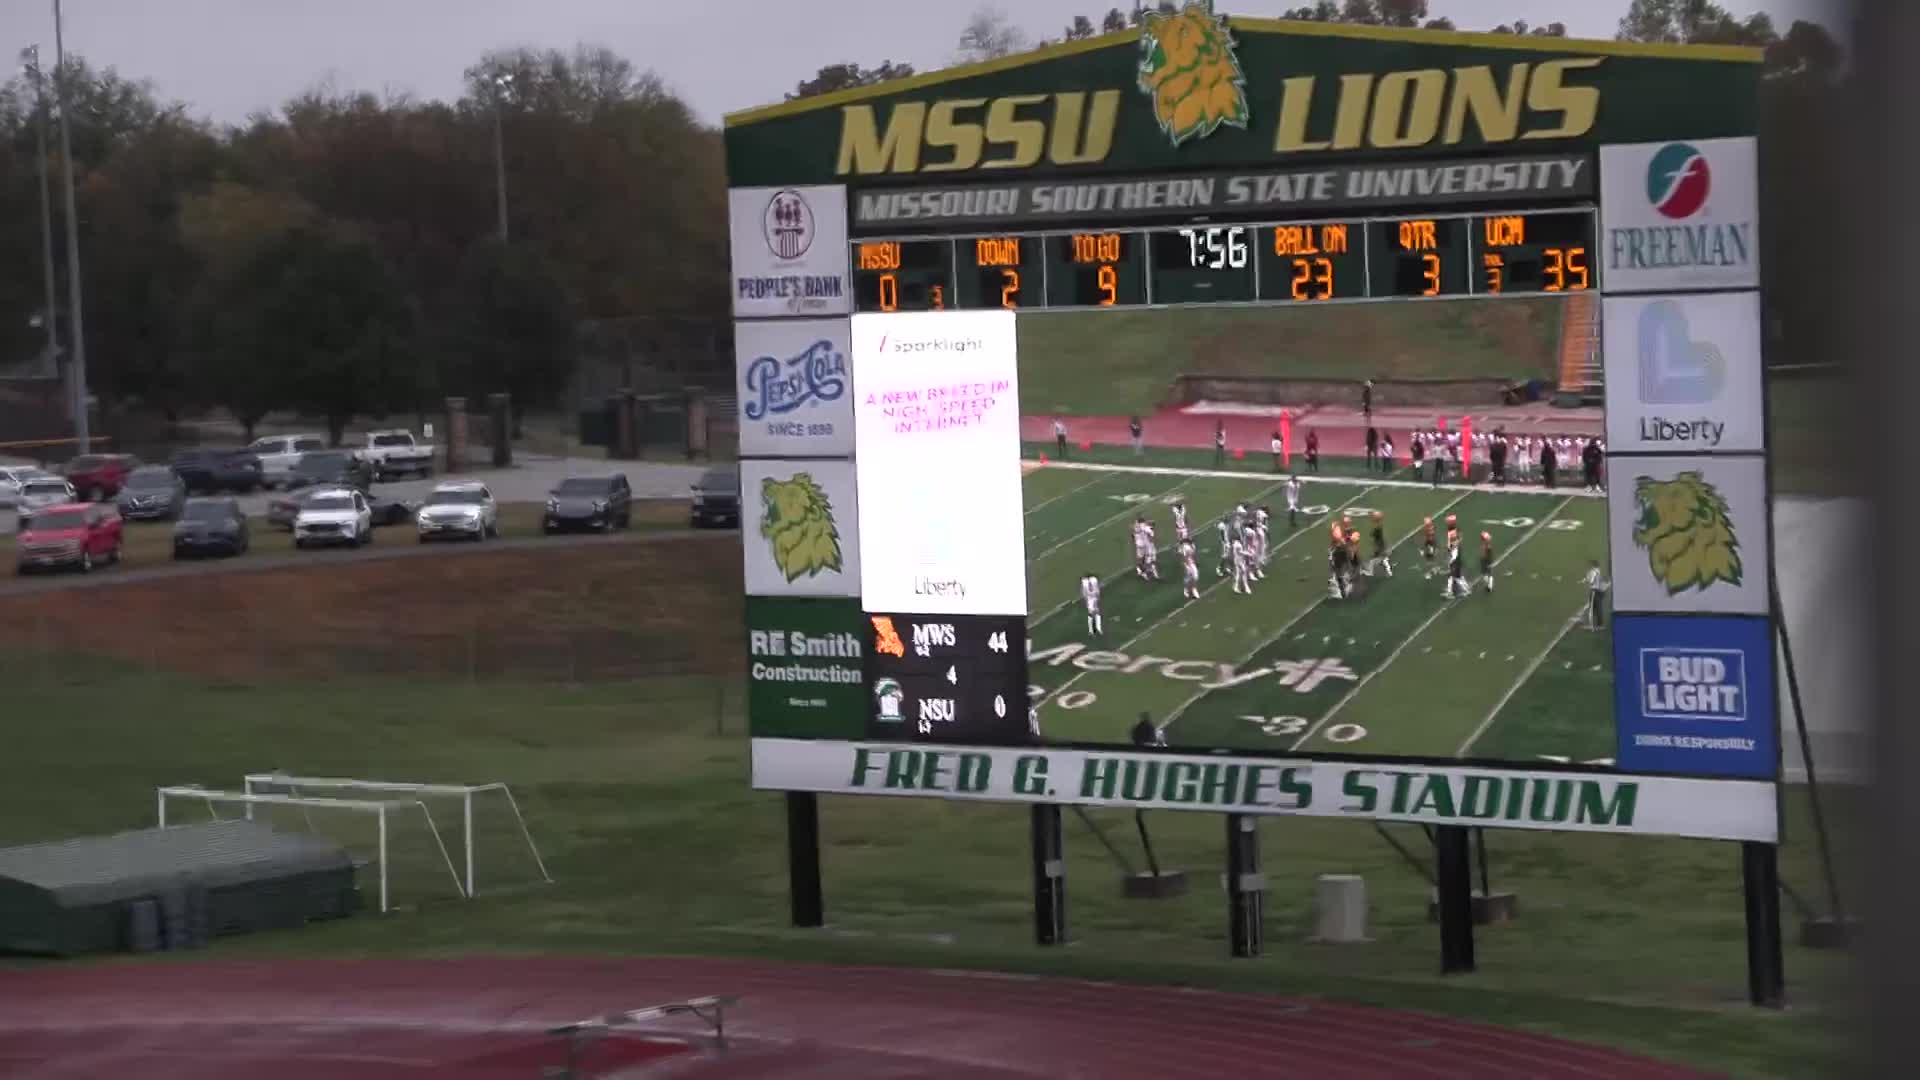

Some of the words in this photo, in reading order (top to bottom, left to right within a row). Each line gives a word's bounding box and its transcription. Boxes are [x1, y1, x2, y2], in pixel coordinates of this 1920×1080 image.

[836, 90, 1121, 175] MSSU
[1273, 56, 1608, 152] LIONS
[859, 189, 1019, 220] MISSOURI
[1031, 178, 1215, 213] SOUTHERN
[1224, 172, 1337, 203] STATE
[1346, 160, 1584, 198] UNIVERSITY
[1274, 226, 1319, 256] BALL
[1323, 224, 1347, 254] ON
[1400, 220, 1437, 251] QTR
[1485, 216, 1525, 246] UCM
[1609, 223, 1751, 269] FREEMAN
[859, 241, 900, 270] MSSU
[976, 237, 1020, 266] DOWN
[1073, 235, 1095, 263] TO
[1098, 233, 1120, 261] GO
[1179, 226, 1247, 269] 7:56
[1292, 258, 1333, 300] 23
[1423, 254, 1440, 296] 3
[1543, 247, 1588, 292] 35
[738, 276, 800, 299] PEOPLE'S
[805, 275, 843, 297] BANK
[880, 273, 897, 311] 0
[1002, 269, 1018, 309] 2
[1098, 265, 1116, 306] 9
[882, 389, 921, 404] NEW
[768, 423, 804, 436] SINCE
[1640, 417, 1725, 446] Liberty
[751, 630, 785, 656] RE
[791, 631, 862, 657] Smith
[912, 624, 956, 646] MWS
[988, 631, 1008, 653] 44
[752, 662, 862, 684] Construction
[946, 665, 957, 685] 4
[1026, 639, 1274, 689] Mercy
[1658, 656, 1725, 684] BUD
[919, 698, 955, 721] NSU
[994, 695, 1006, 718] 0
[1647, 684, 1740, 713] LIGHT
[851, 748, 993, 792] FRED
[1013, 755, 1055, 796] G.
[1080, 757, 1313, 810] HUGHES
[1341, 769, 1639, 827] STADIUM
